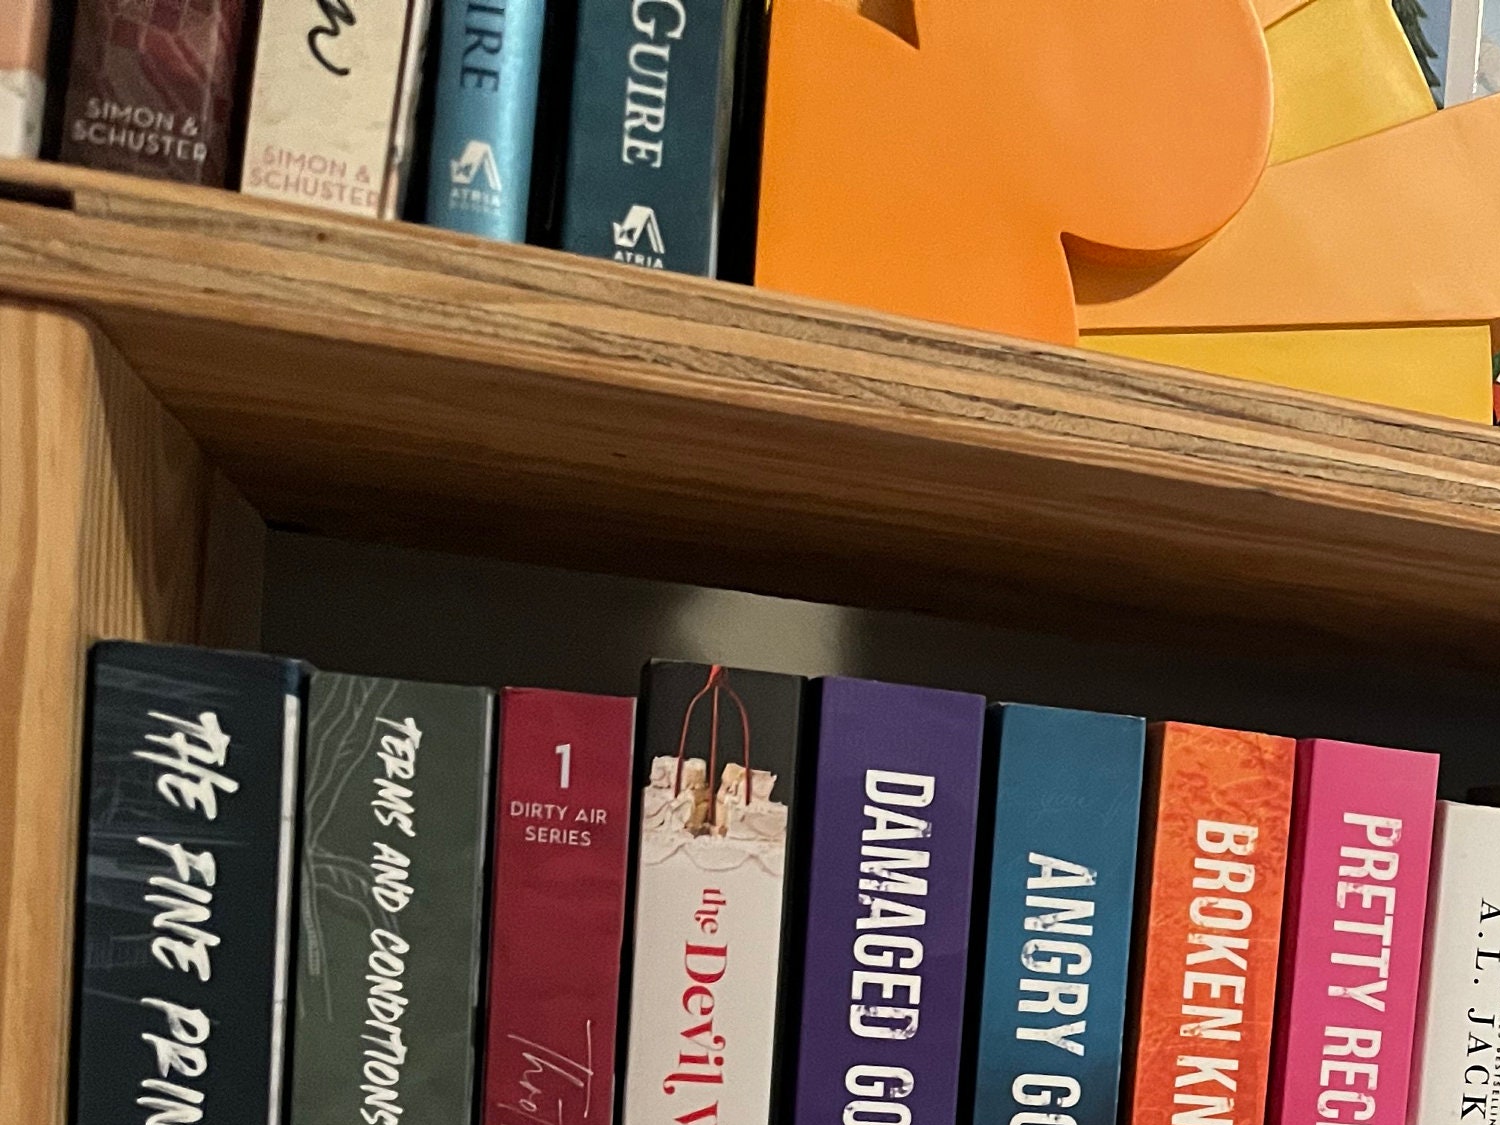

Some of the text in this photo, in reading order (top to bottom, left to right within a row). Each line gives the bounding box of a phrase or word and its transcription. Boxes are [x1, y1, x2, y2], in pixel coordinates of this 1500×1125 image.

[72, 119, 207, 162] SCHUSTER
[87, 98, 198, 136] SIMON &
[132, 710, 240, 820] THE
[371, 715, 424, 838] TERMS
[510, 800, 608, 825] DIRTY AIR
[555, 743, 572, 789] 1
[369, 842, 415, 913] AND
[524, 827, 592, 847] SERIES
[136, 835, 221, 983] FINE
[694, 888, 727, 935] the
[848, 768, 936, 1041] DAMAGED
[1015, 851, 1098, 1057] ANGRY
[1178, 818, 1260, 1043] BROKEN
[1327, 811, 1404, 1013] PRETTY
[662, 940, 729, 1096] Devil
